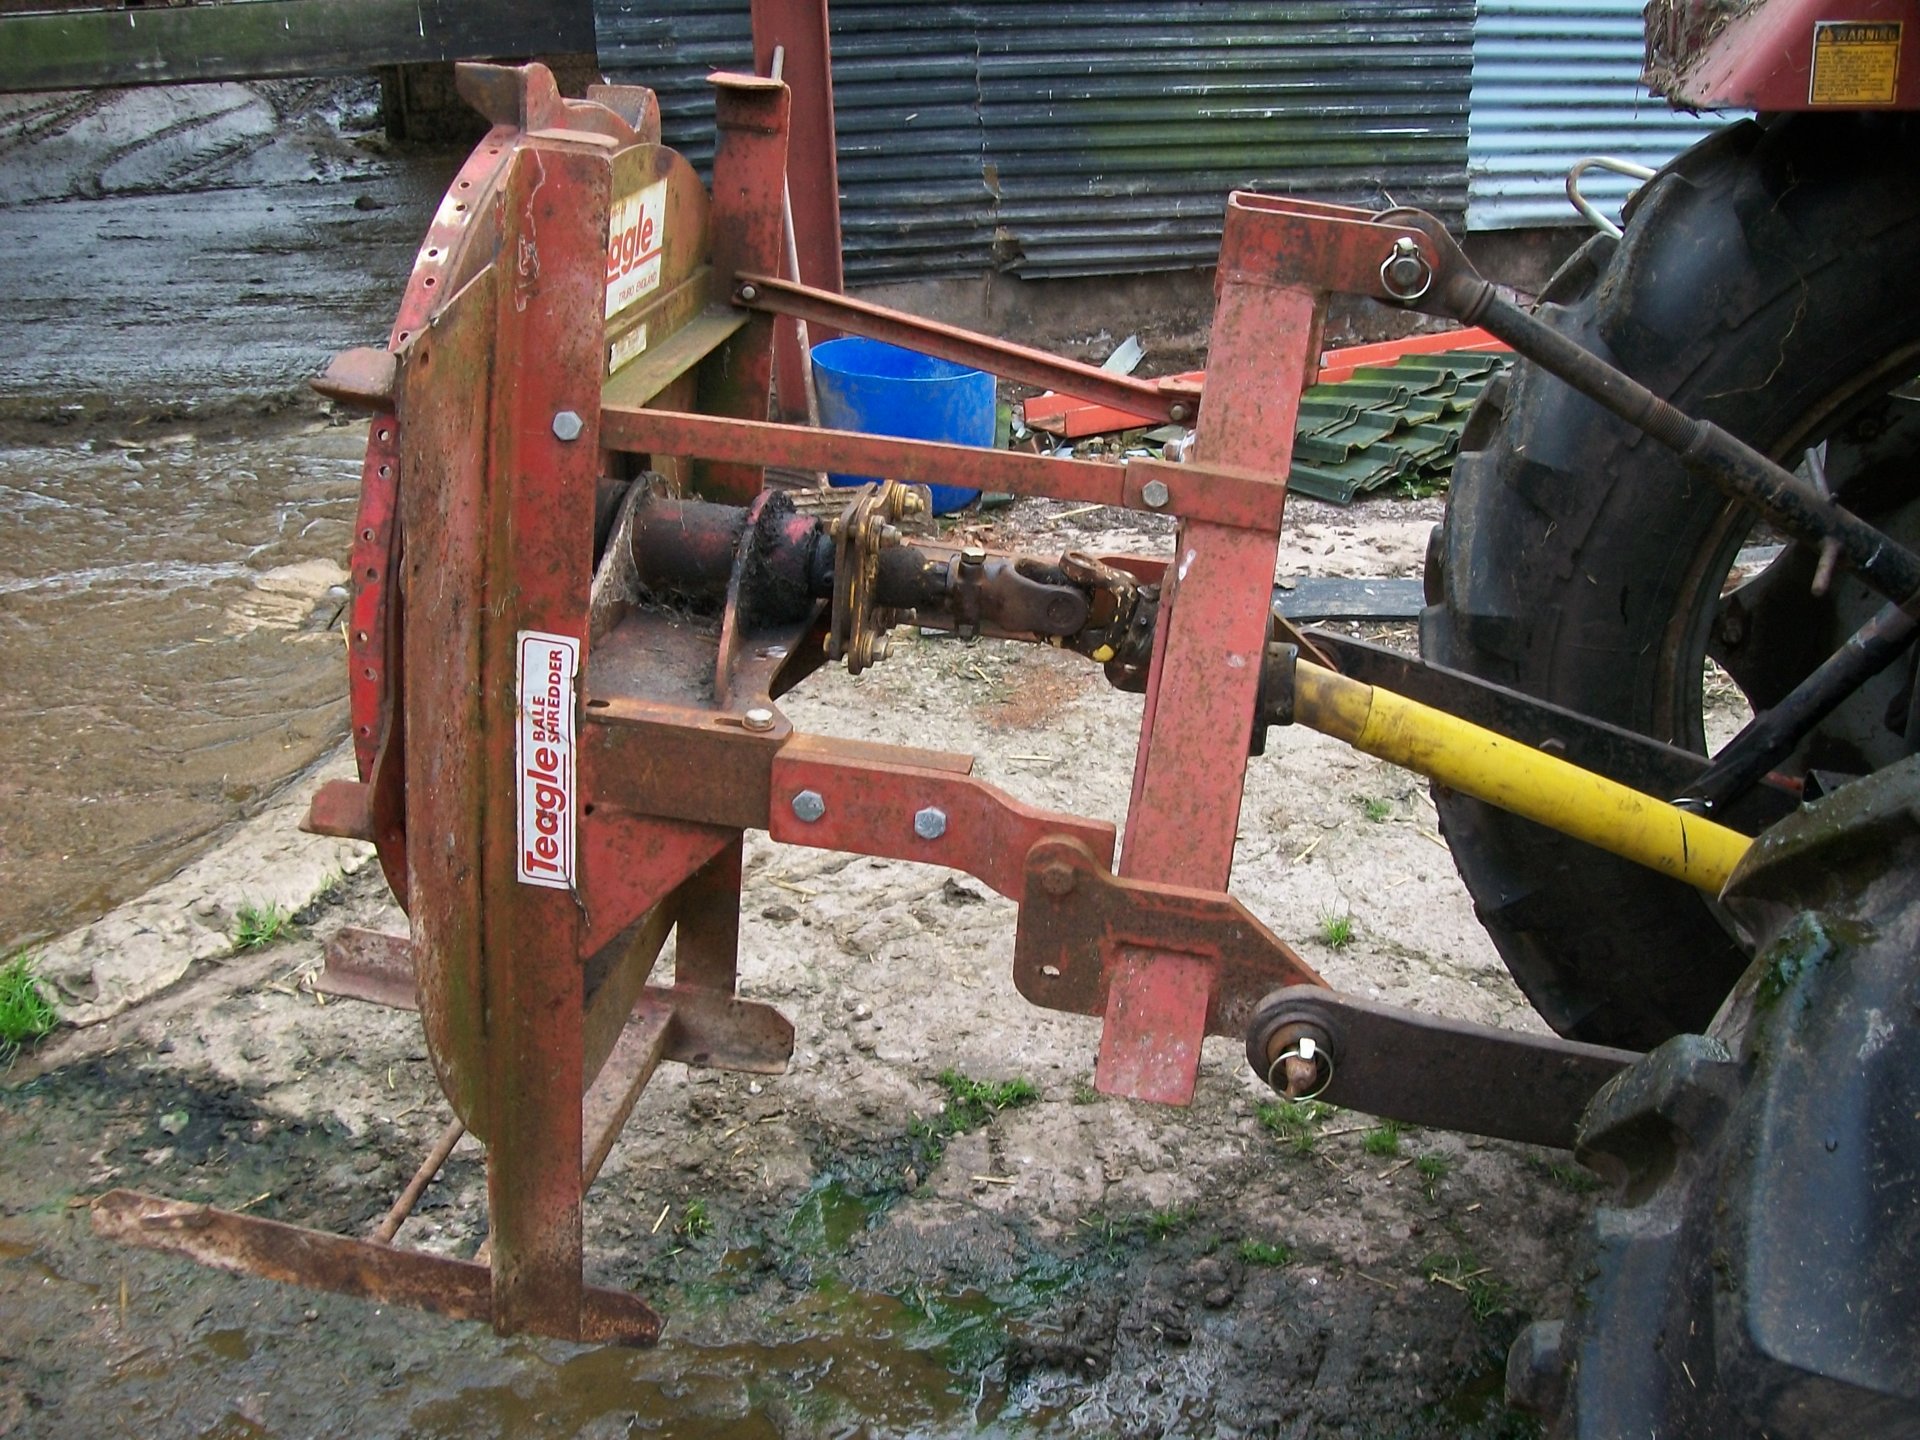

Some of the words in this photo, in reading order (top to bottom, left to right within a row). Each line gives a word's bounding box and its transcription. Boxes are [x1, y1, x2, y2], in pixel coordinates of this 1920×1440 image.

[1837, 28, 1896, 41] WARNING
[608, 203, 653, 275] agle
[532, 695, 546, 743] BALE
[548, 649, 563, 745] SHREDDER
[526, 746, 566, 873] Teagle
